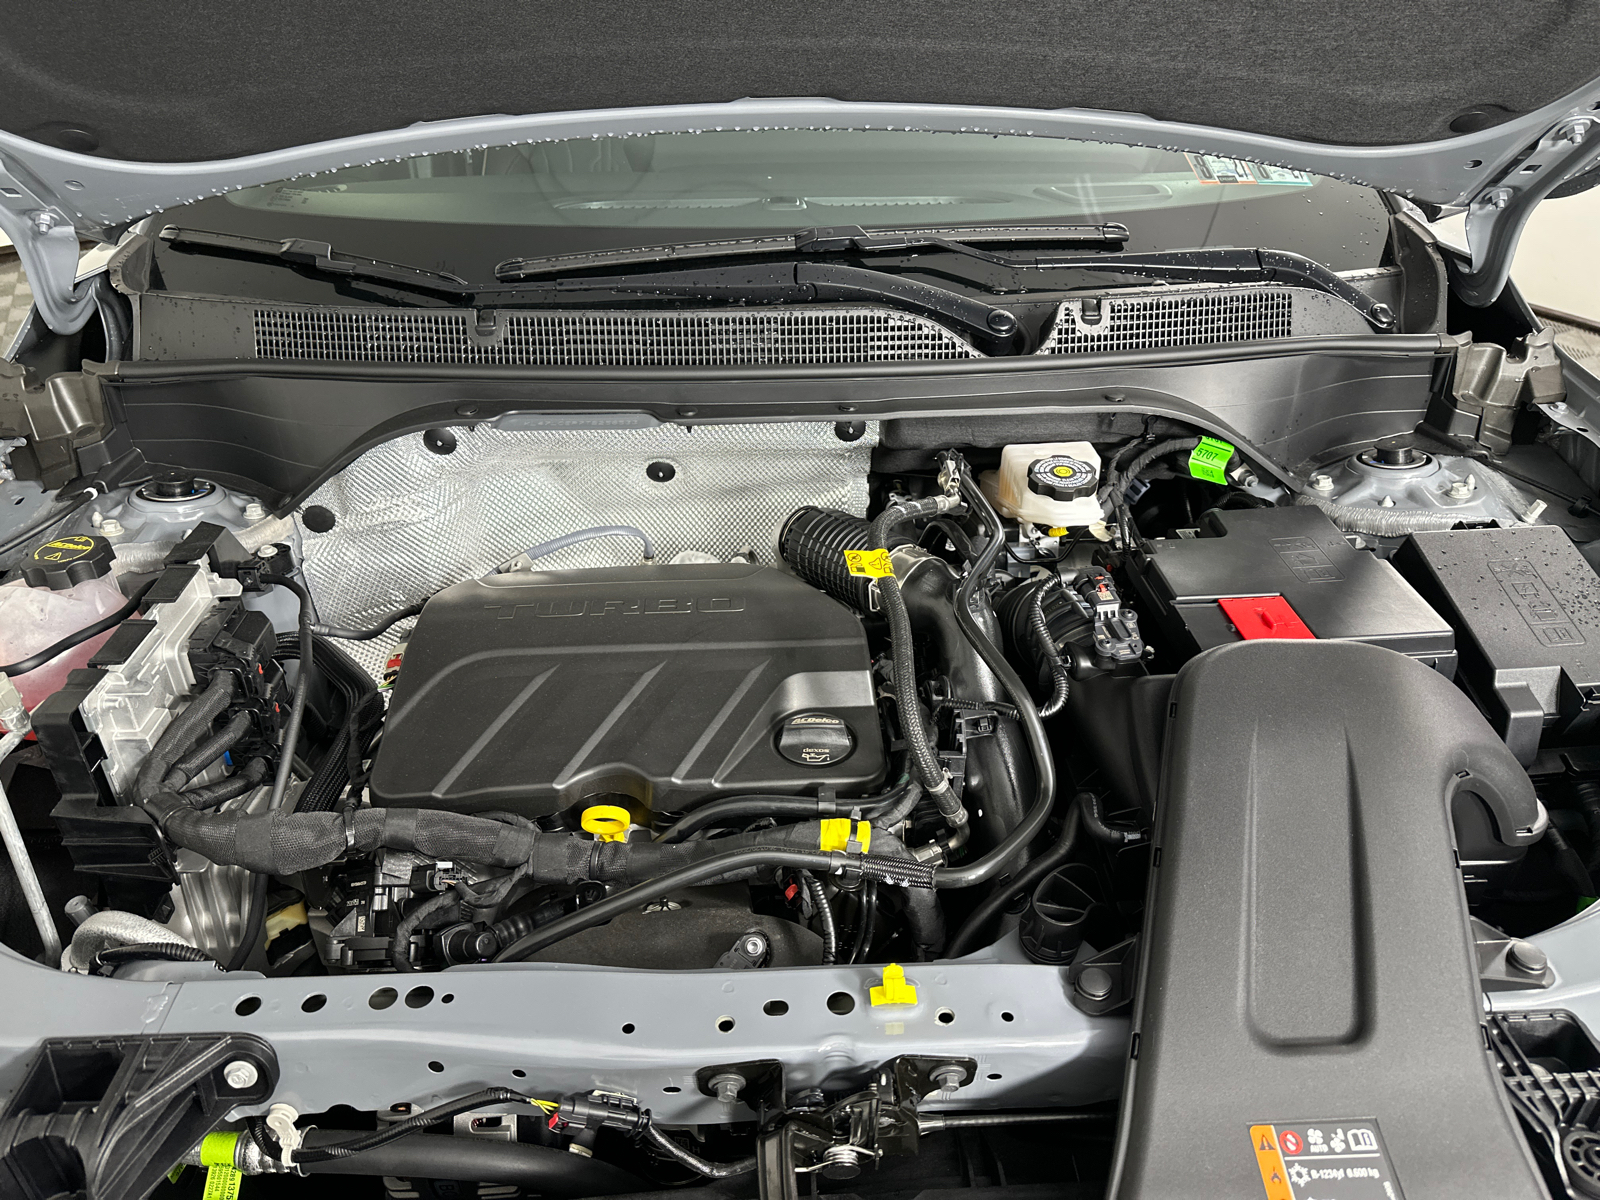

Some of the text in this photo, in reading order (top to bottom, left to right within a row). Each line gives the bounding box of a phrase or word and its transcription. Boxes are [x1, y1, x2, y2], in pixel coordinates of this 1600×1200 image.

[1196, 447, 1219, 462] 5707
[483, 596, 747, 620] TURBO
[790, 717, 840, 725] ACDelco
